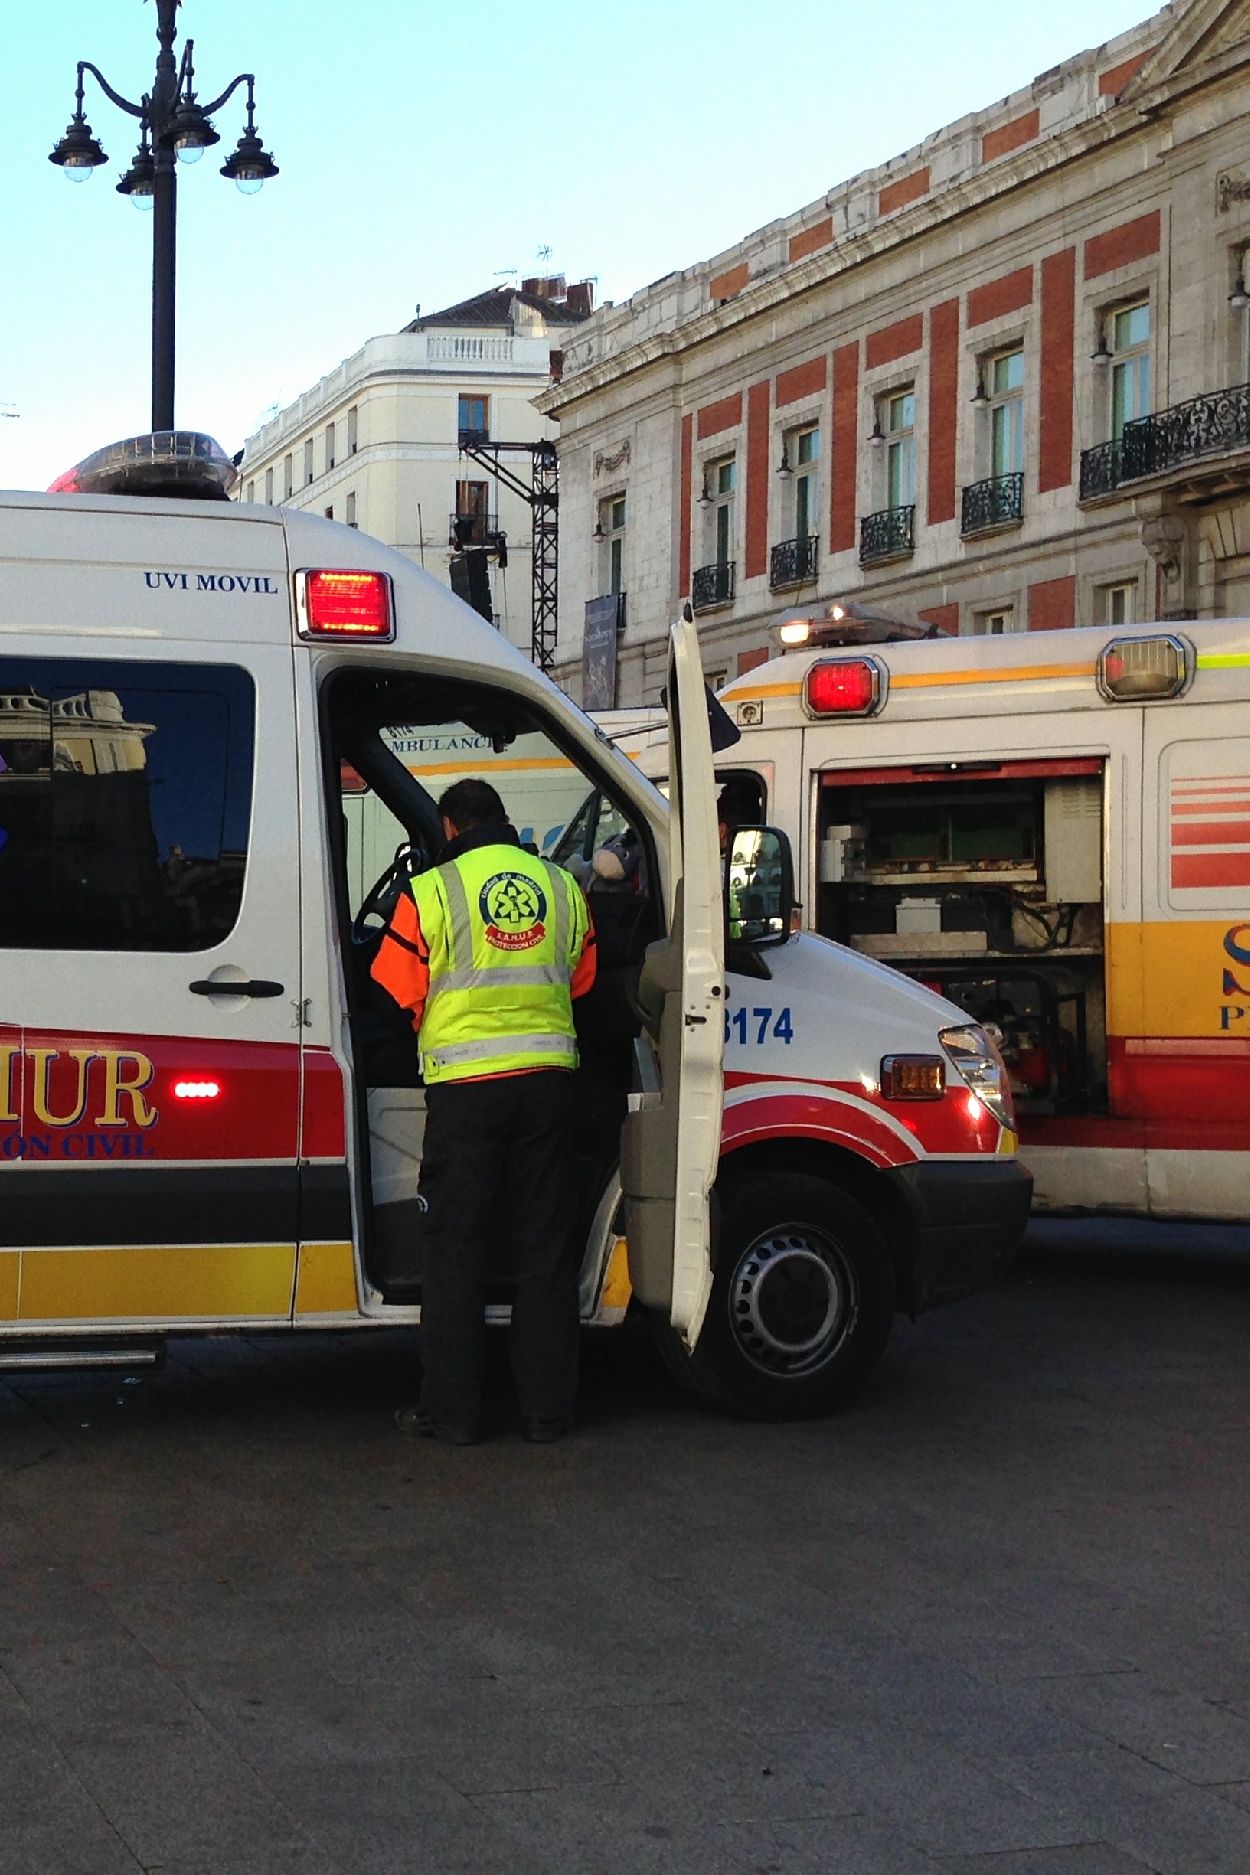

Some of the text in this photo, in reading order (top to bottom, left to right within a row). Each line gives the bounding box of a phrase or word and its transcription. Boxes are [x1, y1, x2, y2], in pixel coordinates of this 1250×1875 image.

[143, 572, 278, 594] UVI MOVIL
[63, 1132, 155, 1158] CIVIL
